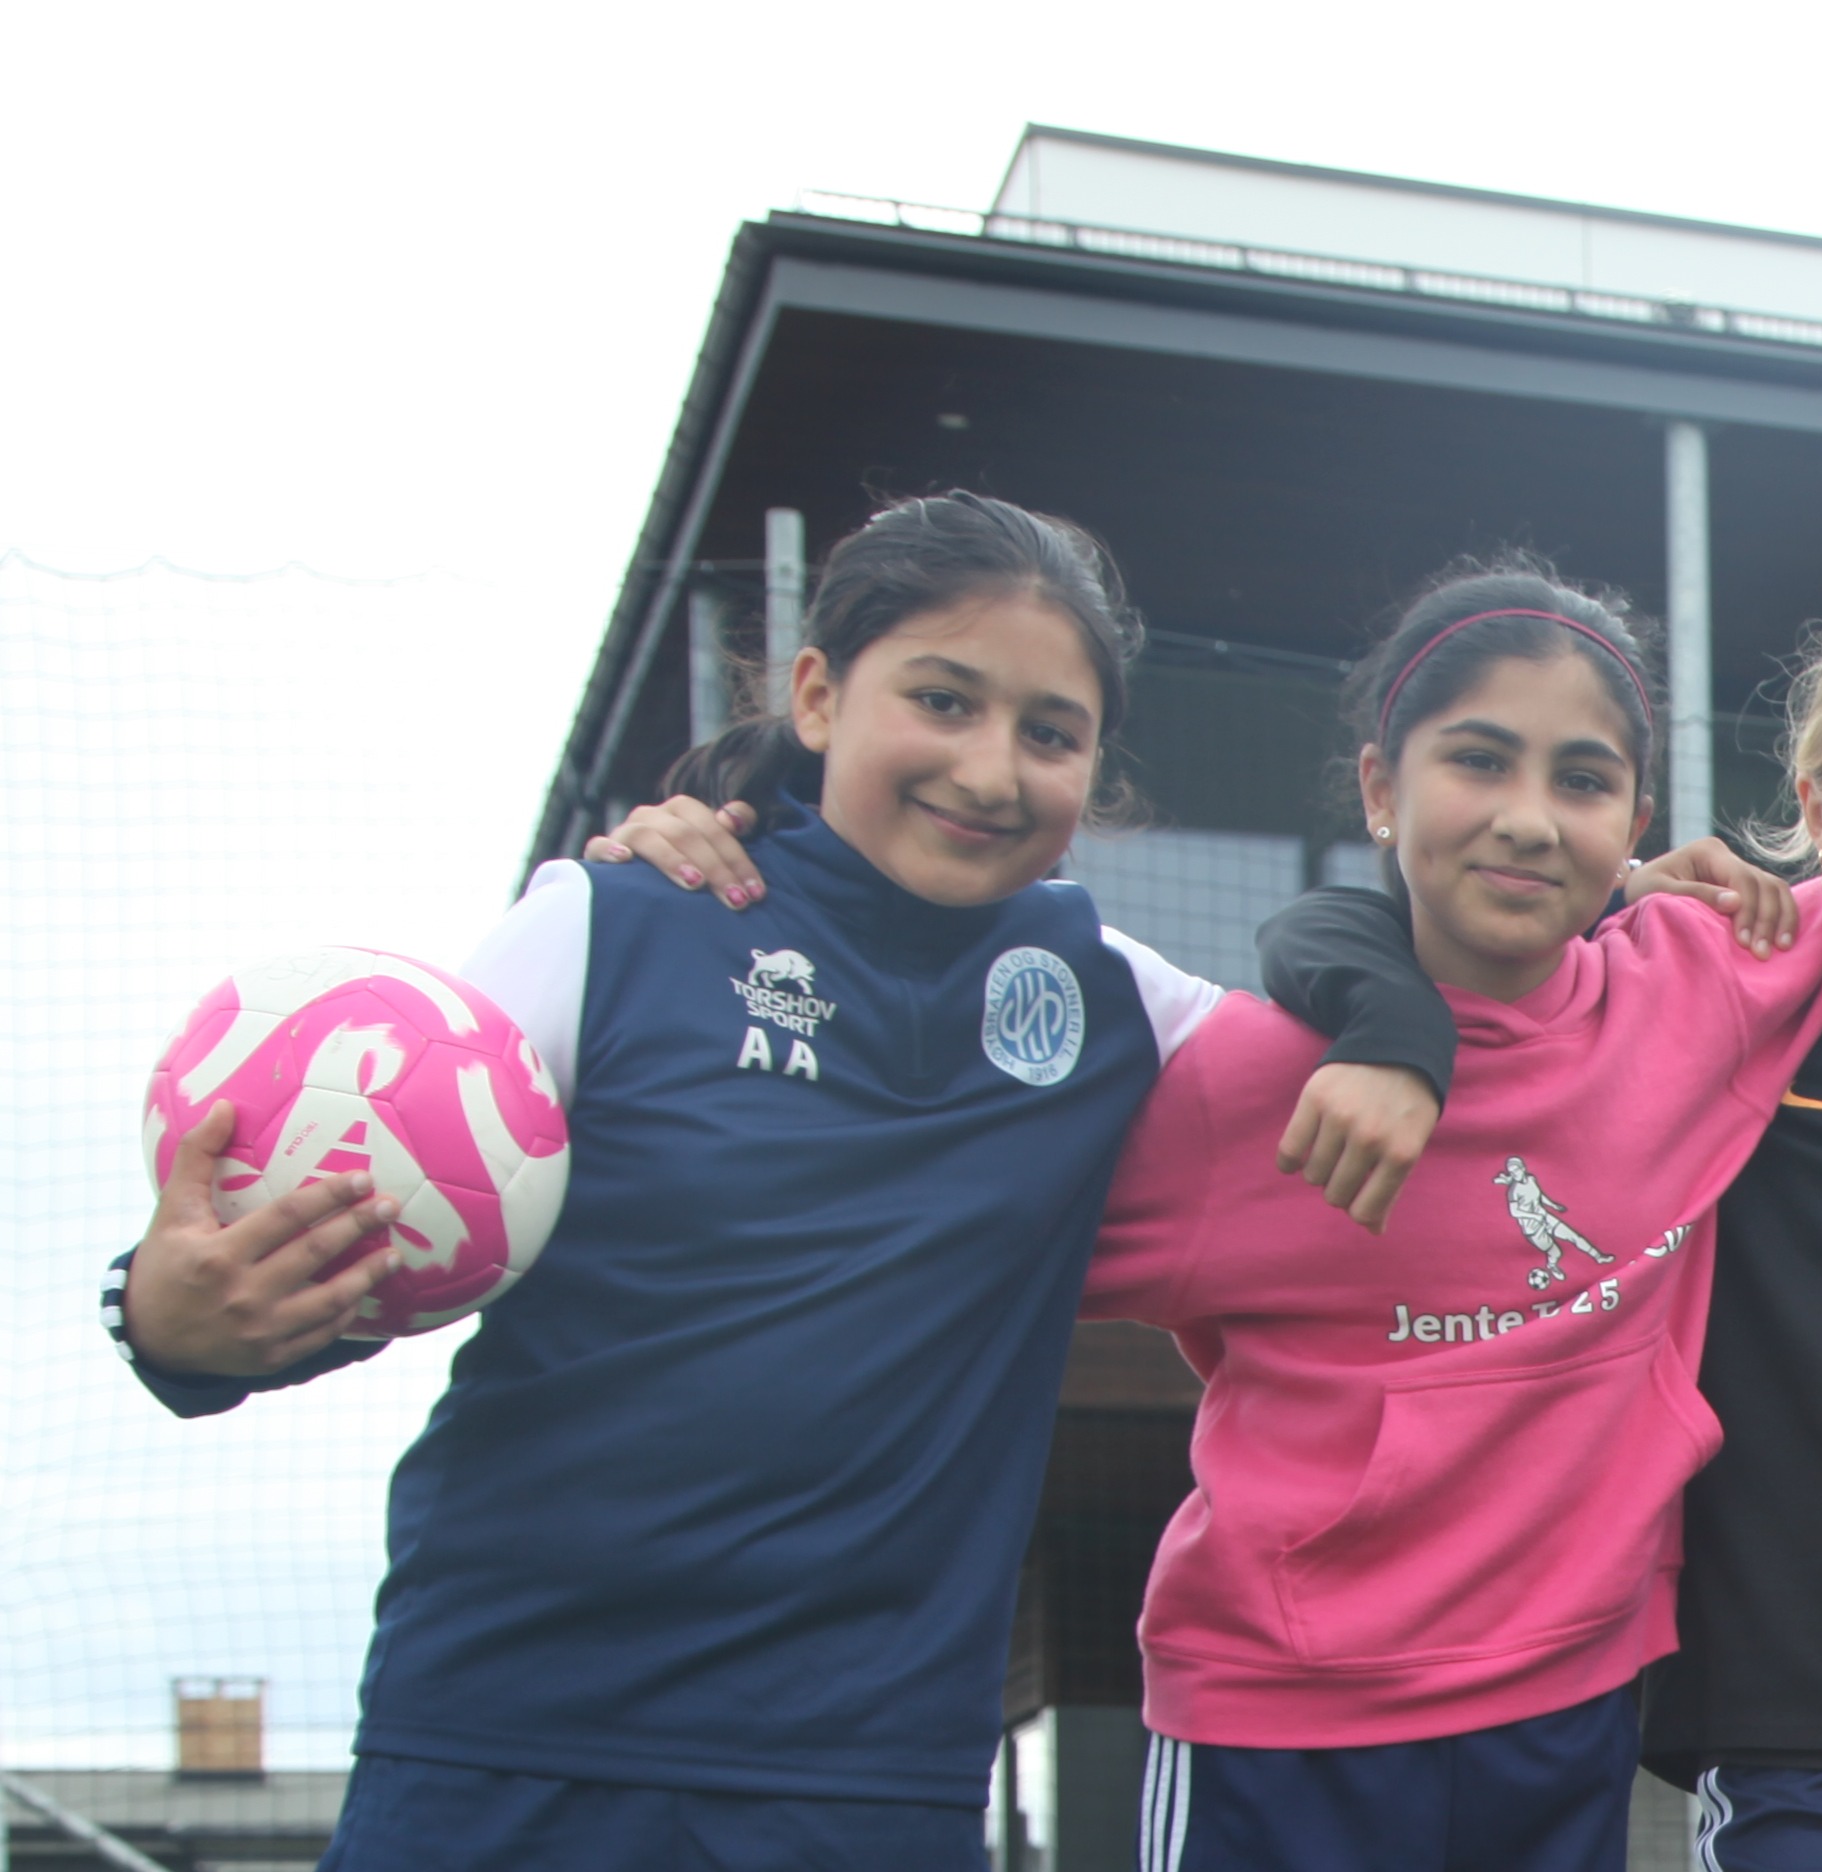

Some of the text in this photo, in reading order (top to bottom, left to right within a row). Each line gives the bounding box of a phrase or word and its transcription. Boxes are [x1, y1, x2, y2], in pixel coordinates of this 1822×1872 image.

[729, 977, 837, 1021] TORSHOV
[1009, 951, 1035, 968] OG
[1040, 953, 1080, 1034] STOVNER
[747, 1000, 819, 1037] SPORT
[1028, 1064, 1058, 1081] 1916
[1388, 1304, 1526, 1343] Jente
